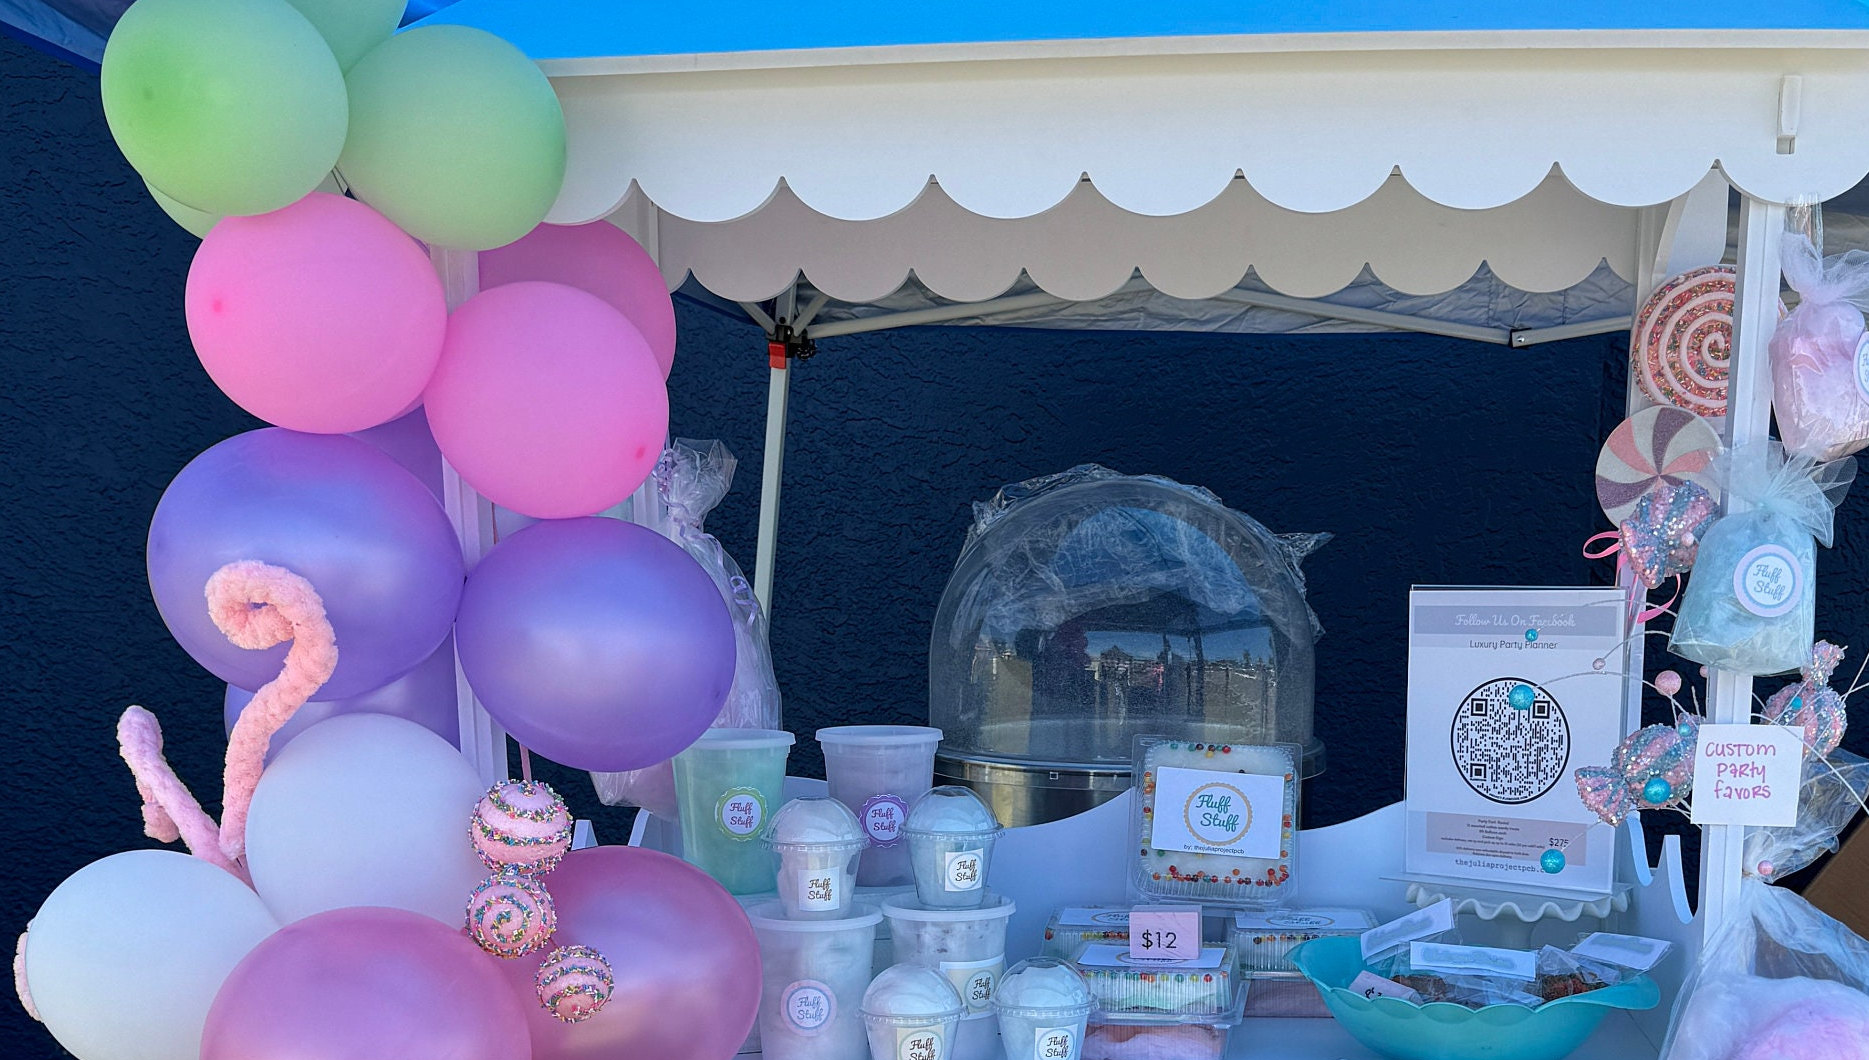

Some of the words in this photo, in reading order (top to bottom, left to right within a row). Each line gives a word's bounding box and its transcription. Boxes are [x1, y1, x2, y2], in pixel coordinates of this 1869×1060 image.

[1752, 564, 1783, 584] Fluff
[1753, 580, 1786, 601] Stuff
[1454, 613, 1490, 627] Follow
[1492, 614, 1509, 627] Us
[1510, 614, 1527, 627] On
[1469, 639, 1498, 650] Luxury
[1499, 639, 1523, 650] Party
[1524, 640, 1558, 650] Planner
[729, 802, 753, 815] Fluff
[1195, 794, 1231, 814] Fluff
[871, 807, 895, 820] Fluff
[730, 816, 754, 828] Stuff
[873, 820, 897, 833] Stuff
[1200, 812, 1240, 832] Stuff
[956, 858, 977, 871] Fluff
[955, 868, 978, 882] Stuff
[808, 877, 831, 890] Fluff
[807, 888, 832, 901] Stuff
[1141, 929, 1177, 950] $12
[797, 995, 822, 1009] Fluff
[797, 1008, 823, 1022] Stuff
[909, 1037, 935, 1051] Fluff
[1046, 1034, 1069, 1047] Fluff
[1045, 1046, 1069, 1059] Stuff
